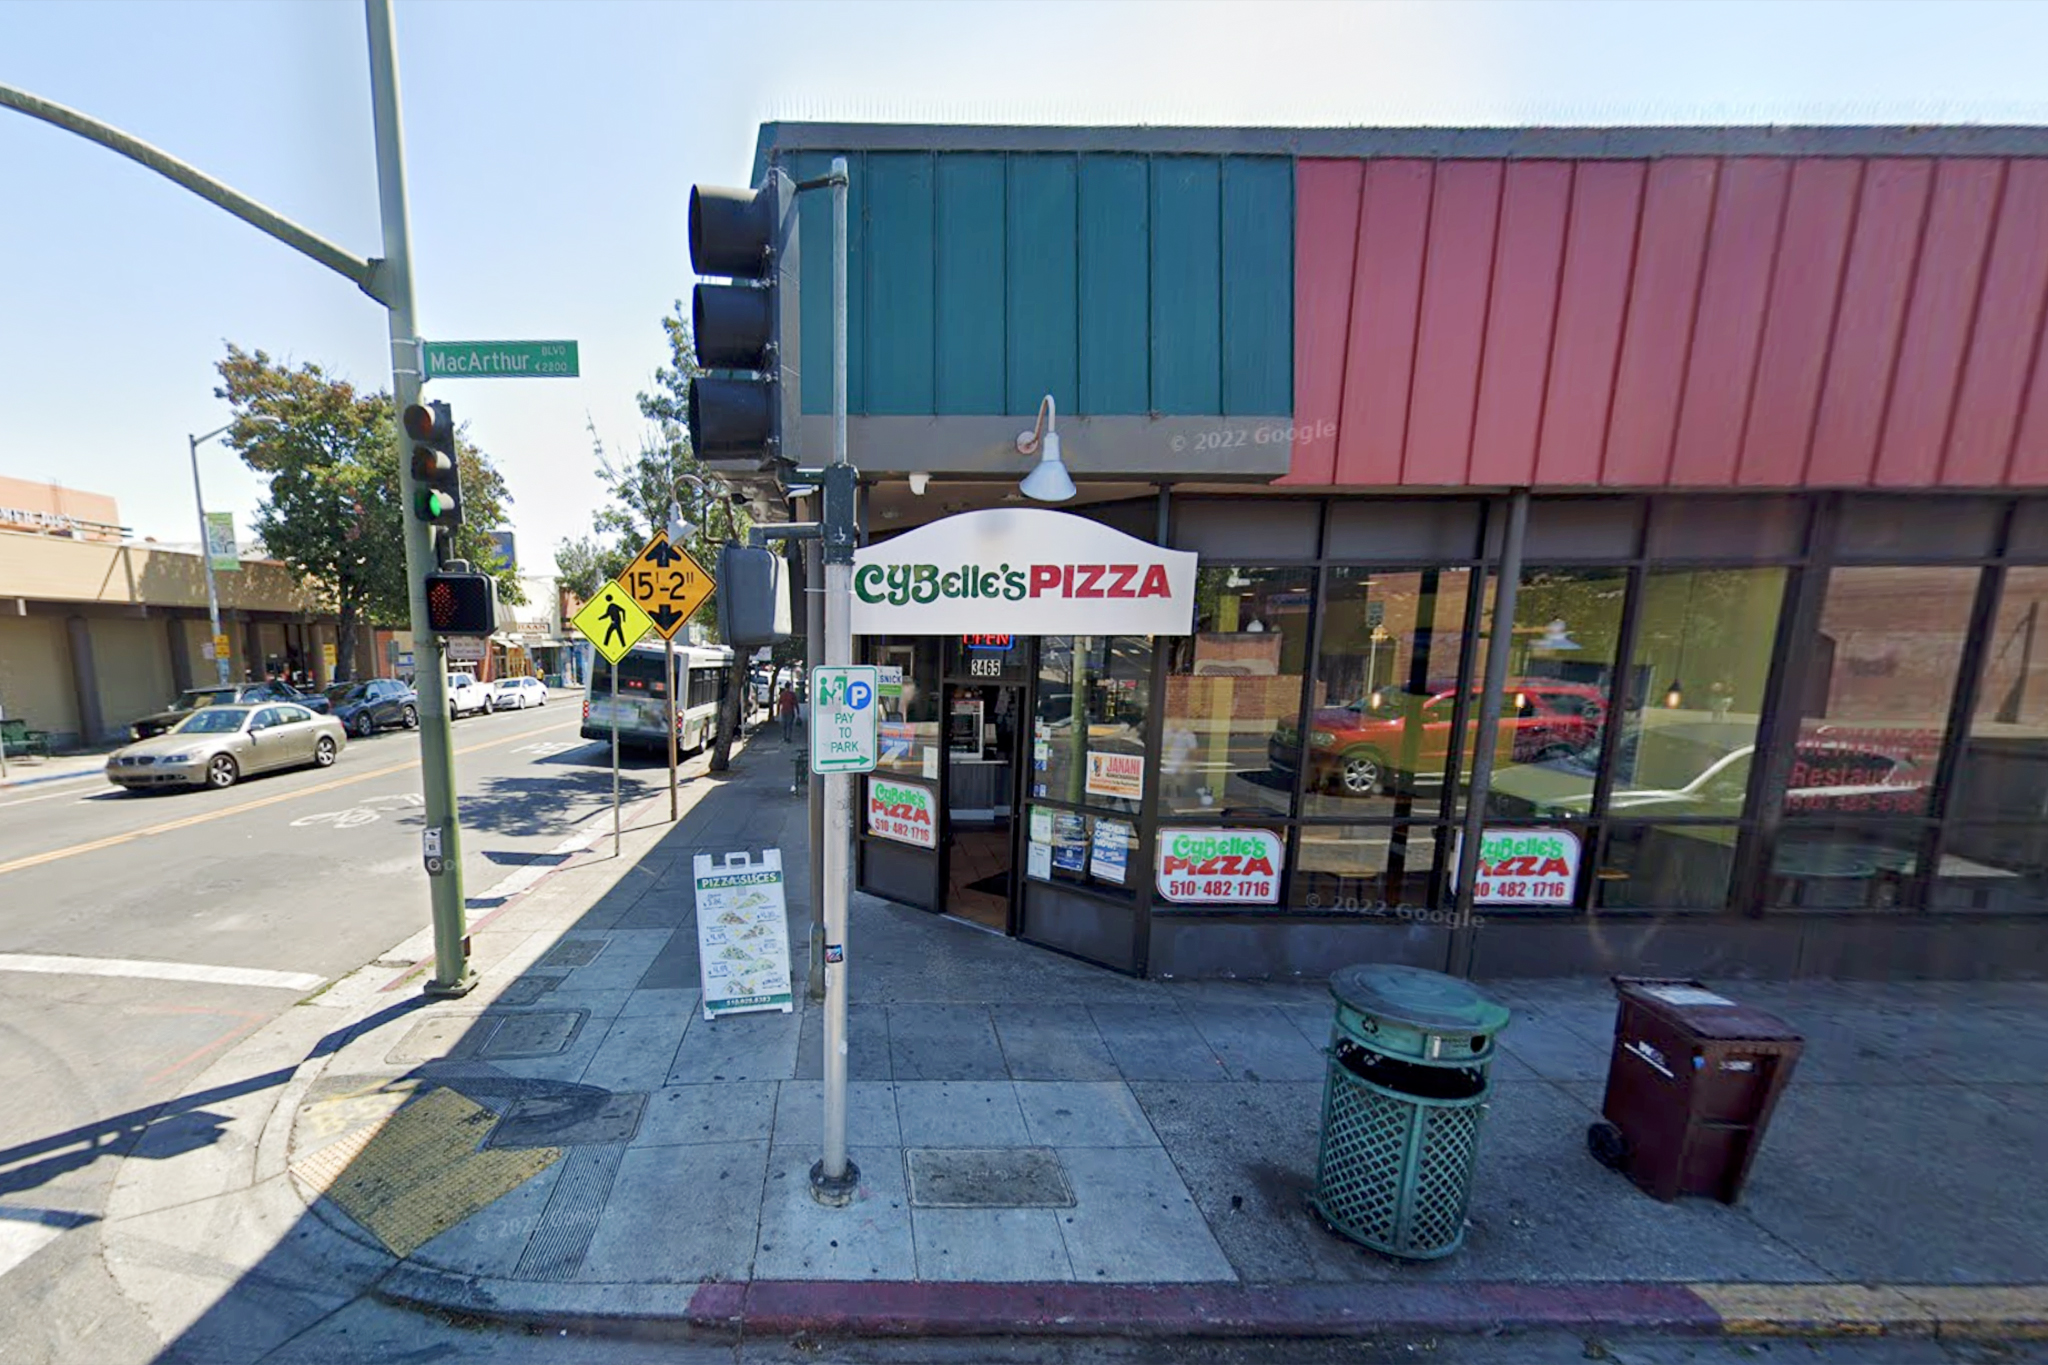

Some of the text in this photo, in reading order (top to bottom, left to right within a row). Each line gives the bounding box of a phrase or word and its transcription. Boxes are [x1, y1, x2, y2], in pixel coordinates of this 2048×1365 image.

[541, 345, 566, 356] BLVD
[431, 352, 529, 372] MacArthur
[1029, 564, 1172, 599] PIZZA
[972, 659, 999, 676] 3465
[834, 712, 855, 724] PAY
[839, 727, 852, 738] TO
[830, 741, 859, 753] PARK
[871, 798, 931, 825] PIZZA
[1163, 855, 1274, 876] PIZZA
[1478, 856, 1570, 877] IZZA
[702, 876, 735, 889] PIZZA
